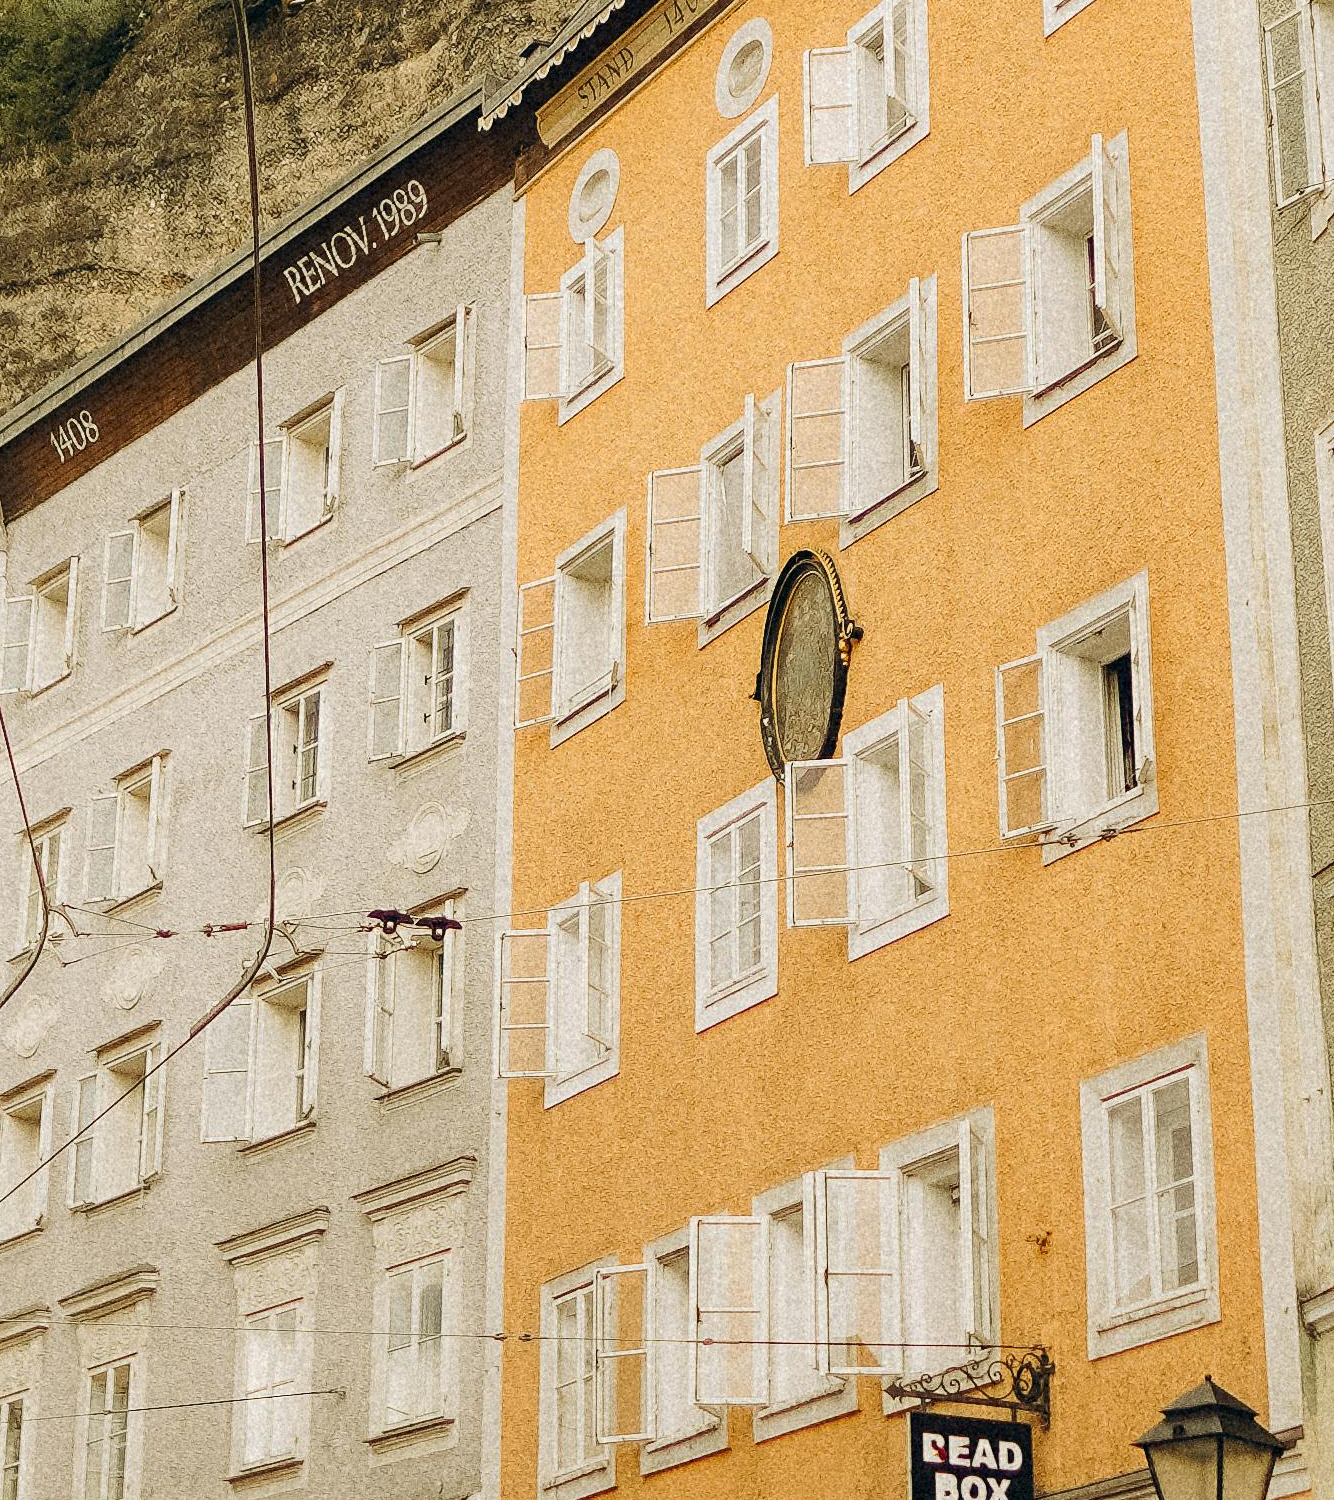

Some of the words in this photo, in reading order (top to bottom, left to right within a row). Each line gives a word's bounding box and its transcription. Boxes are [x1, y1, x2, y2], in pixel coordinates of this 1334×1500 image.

[578, 47, 634, 109] STAND
[282, 215, 377, 304] RENOV.
[371, 179, 429, 243] 1989
[50, 410, 100, 463] 1408
